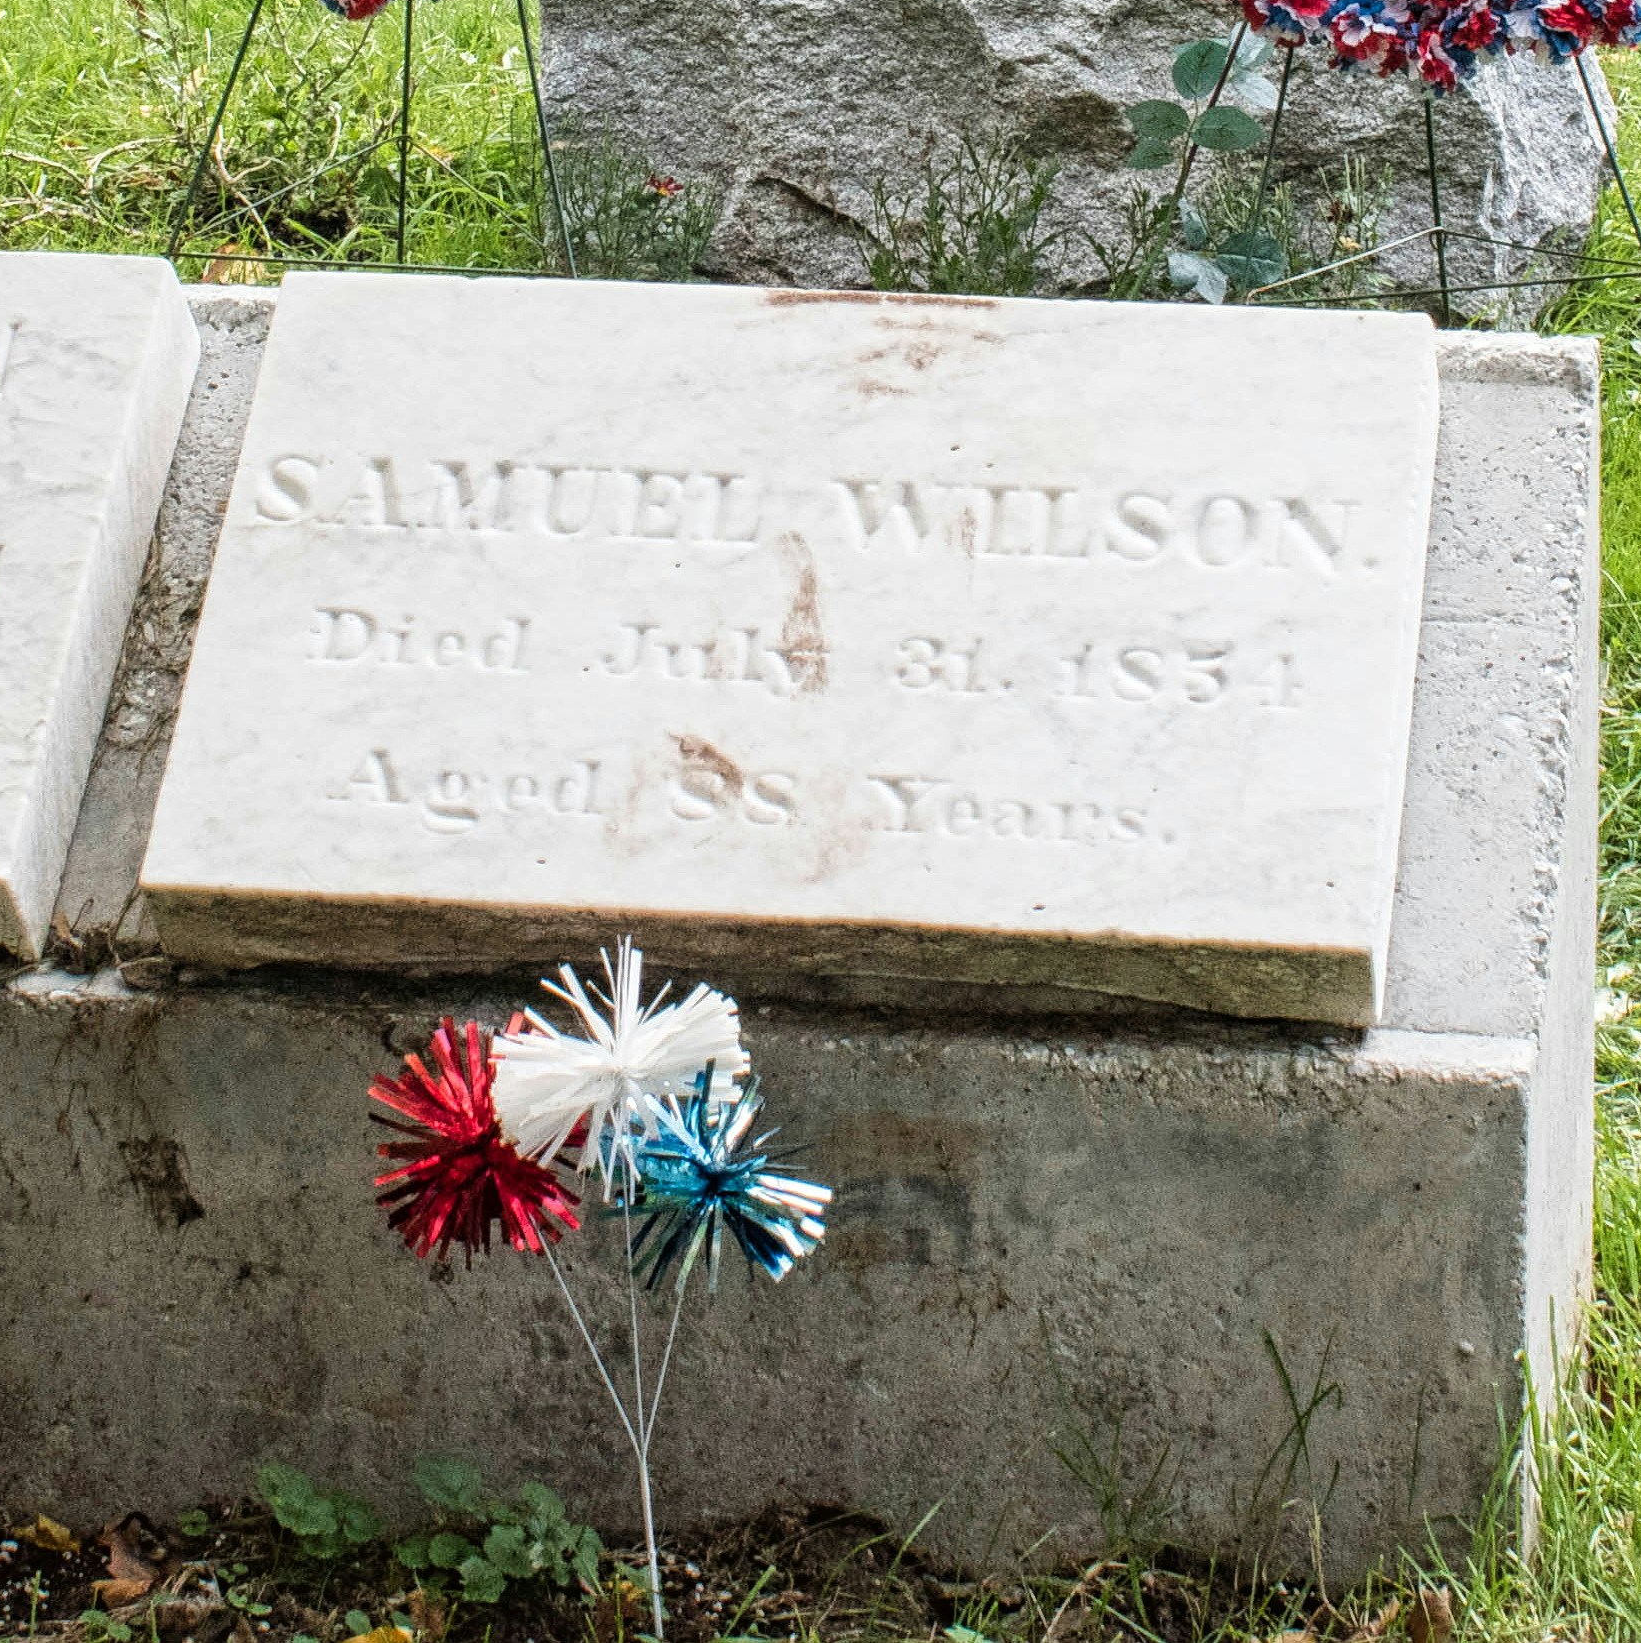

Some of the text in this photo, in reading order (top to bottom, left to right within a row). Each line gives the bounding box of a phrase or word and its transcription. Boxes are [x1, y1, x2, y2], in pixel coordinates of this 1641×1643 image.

[255, 452, 1381, 583] SAMUEL WILSON.
[303, 604, 532, 675] Died
[600, 620, 830, 698] July
[1056, 635, 1304, 709] 1854
[324, 747, 602, 835] Aged
[864, 771, 1178, 847] Years.
